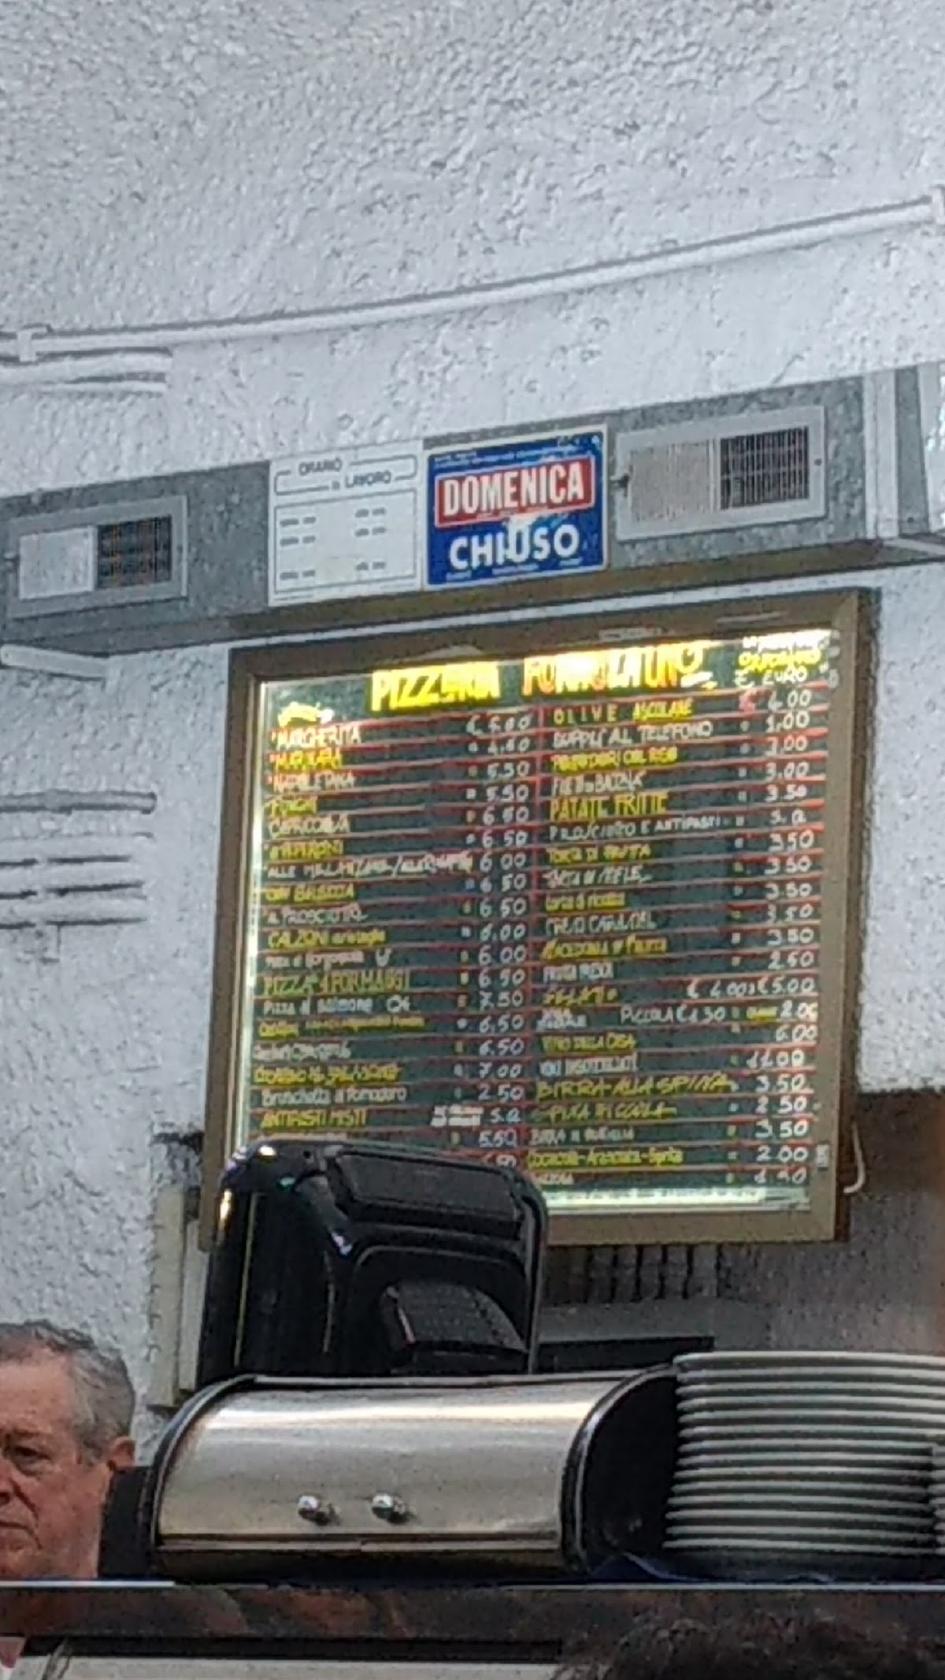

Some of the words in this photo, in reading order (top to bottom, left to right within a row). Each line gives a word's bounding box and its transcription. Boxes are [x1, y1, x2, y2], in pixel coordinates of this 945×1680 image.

[345, 471, 391, 488] LAVORO
[443, 463, 584, 516] DOMENICA
[449, 524, 579, 570] CHIUSO
[554, 704, 618, 724] OLIVE
[551, 797, 609, 821] PATATE
[614, 793, 669, 816] FRITTE
